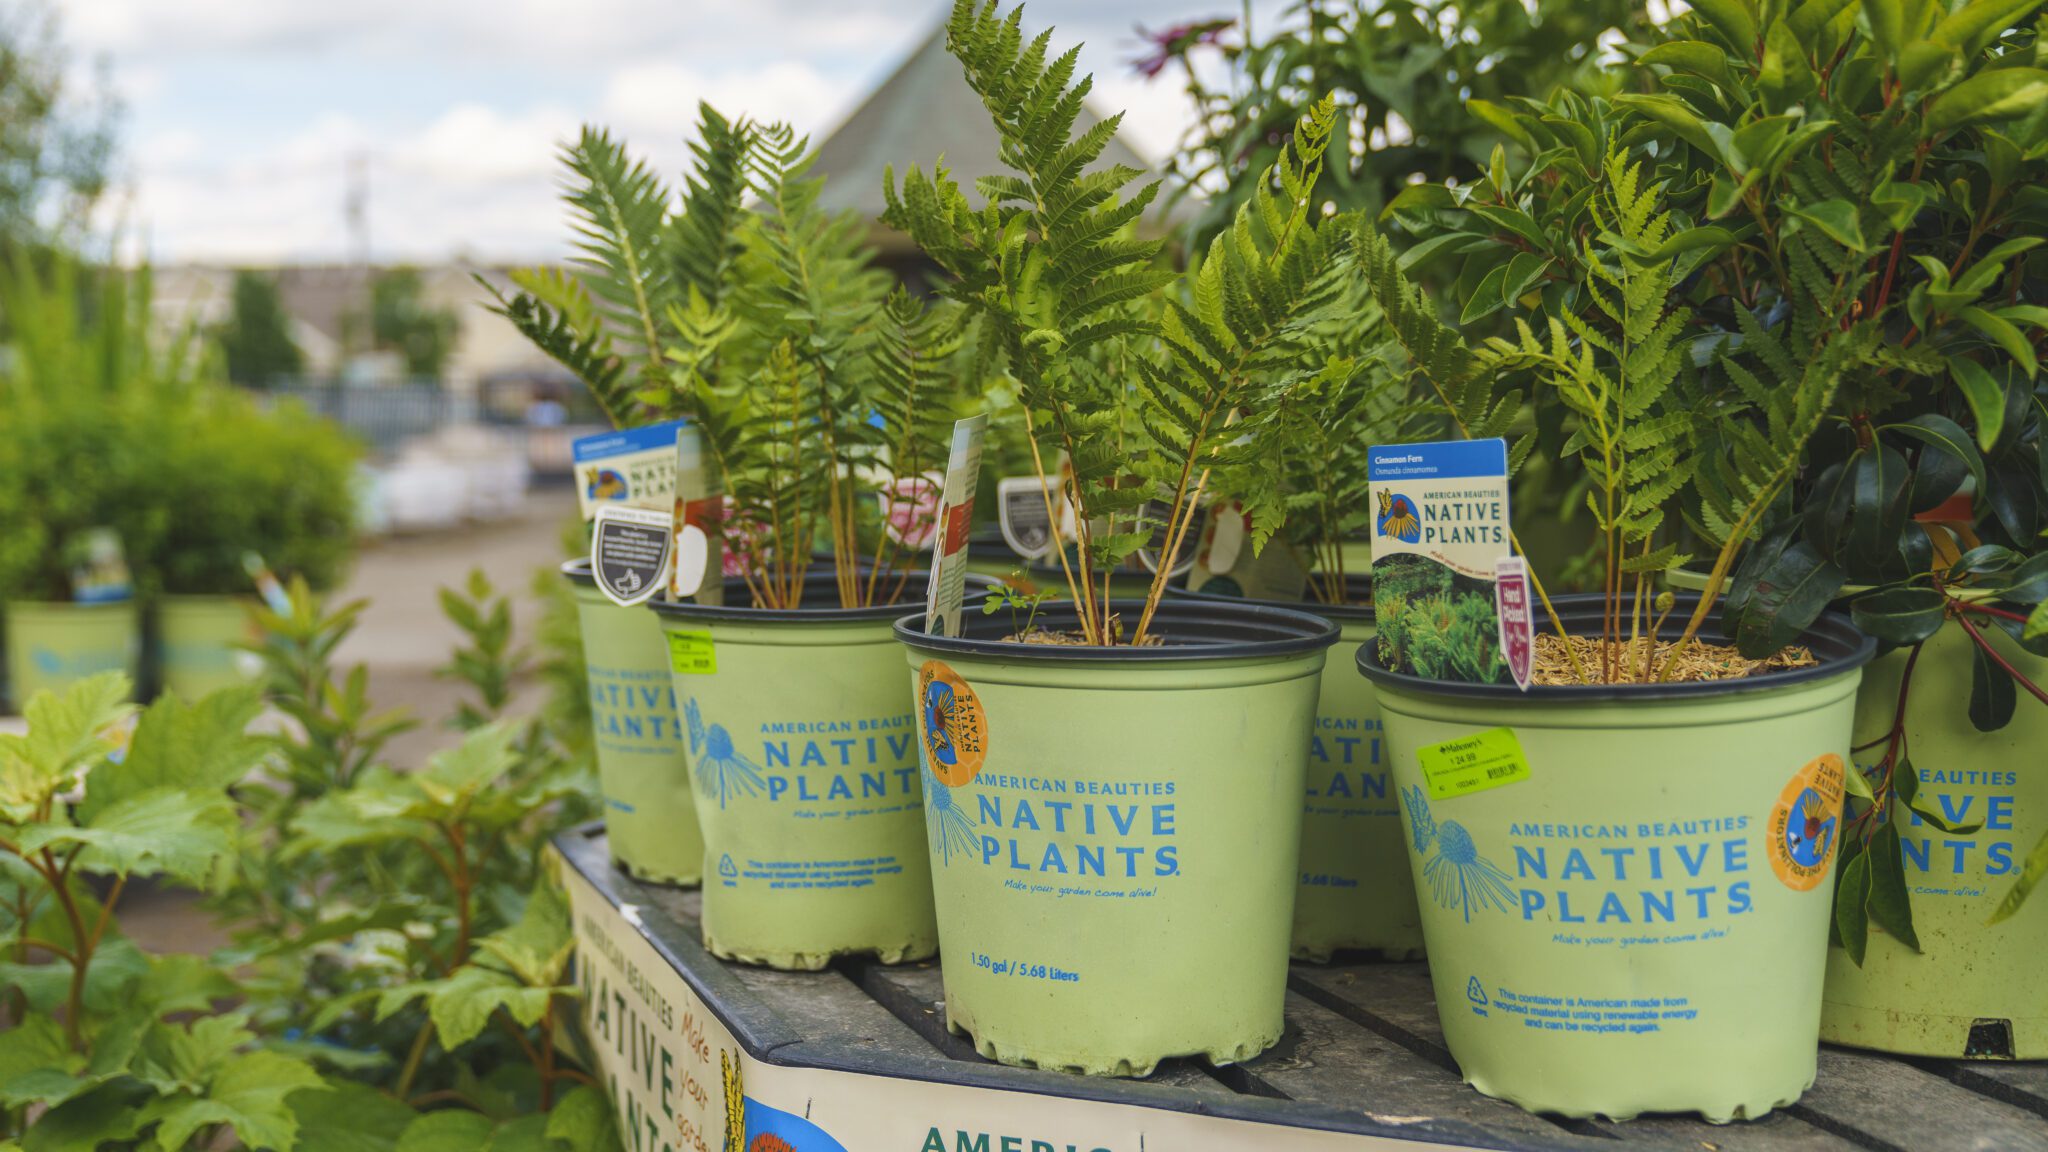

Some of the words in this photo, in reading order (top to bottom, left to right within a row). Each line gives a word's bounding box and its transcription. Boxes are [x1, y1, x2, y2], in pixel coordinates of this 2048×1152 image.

[1375, 455, 1407, 465] Cinnamon
[1408, 454, 1424, 463] Fern
[1375, 467, 1401, 476] Osmunda
[1423, 491, 1461, 500] AMERICAN
[1463, 489, 1500, 498] BEAUTIES
[1424, 502, 1501, 521] NATIVE
[1425, 526, 1503, 544] PLANTS
[760, 720, 852, 734] AMERICAN
[858, 714, 913, 732] BEAUT
[957, 695, 973, 752] NATIVE
[965, 694, 981, 753] PLANTS
[763, 733, 912, 768] NATIV
[768, 766, 917, 802] PLANT
[974, 772, 1067, 793] AMERICAN
[1074, 780, 1176, 796] BEAUTIES
[1919, 768, 2017, 786] EAUTIES
[976, 793, 1176, 836] NATIVE
[1509, 822, 1629, 840] AMERICAN
[1637, 815, 1749, 838] BEAUTIES
[1512, 838, 1749, 881] NATIVE
[1004, 879, 1027, 891] Make
[1030, 883, 1054, 894] your
[1058, 886, 1091, 898] garden
[1094, 888, 1125, 898] come
[1129, 887, 1158, 898] alive!
[1914, 886, 1950, 896] come
[1953, 885, 1987, 897] alive!
[1552, 932, 1582, 945] Make
[1584, 935, 1616, 947] your
[1619, 933, 1660, 949] garden
[1663, 933, 1697, 945] come
[1701, 926, 1731, 940] alive!
[971, 951, 991, 969] 1.50
[991, 959, 1008, 975] gal
[1019, 963, 1047, 979] 5.68
[1049, 966, 1080, 982] Liters
[626, 958, 674, 1032] BEAUTIES
[1498, 987, 1517, 1001] This
[1518, 994, 1563, 1006] container
[1565, 997, 1575, 1007] is
[1577, 996, 1628, 1008] American
[1630, 998, 1661, 1008] made
[1663, 997, 1688, 1007] from
[1493, 1000, 1528, 1014] recycled
[1530, 1007, 1570, 1018] material
[1572, 1010, 1602, 1022] using
[1603, 1010, 1660, 1020] renewable
[1661, 1009, 1698, 1020] energy
[581, 954, 674, 1121] NATIVE
[681, 1011, 709, 1064] Make
[1524, 1018, 1543, 1029] and
[1544, 1020, 1564, 1031] can
[1565, 1020, 1579, 1031] be
[1581, 1023, 1627, 1034] recycled
[679, 1067, 709, 1112] your
